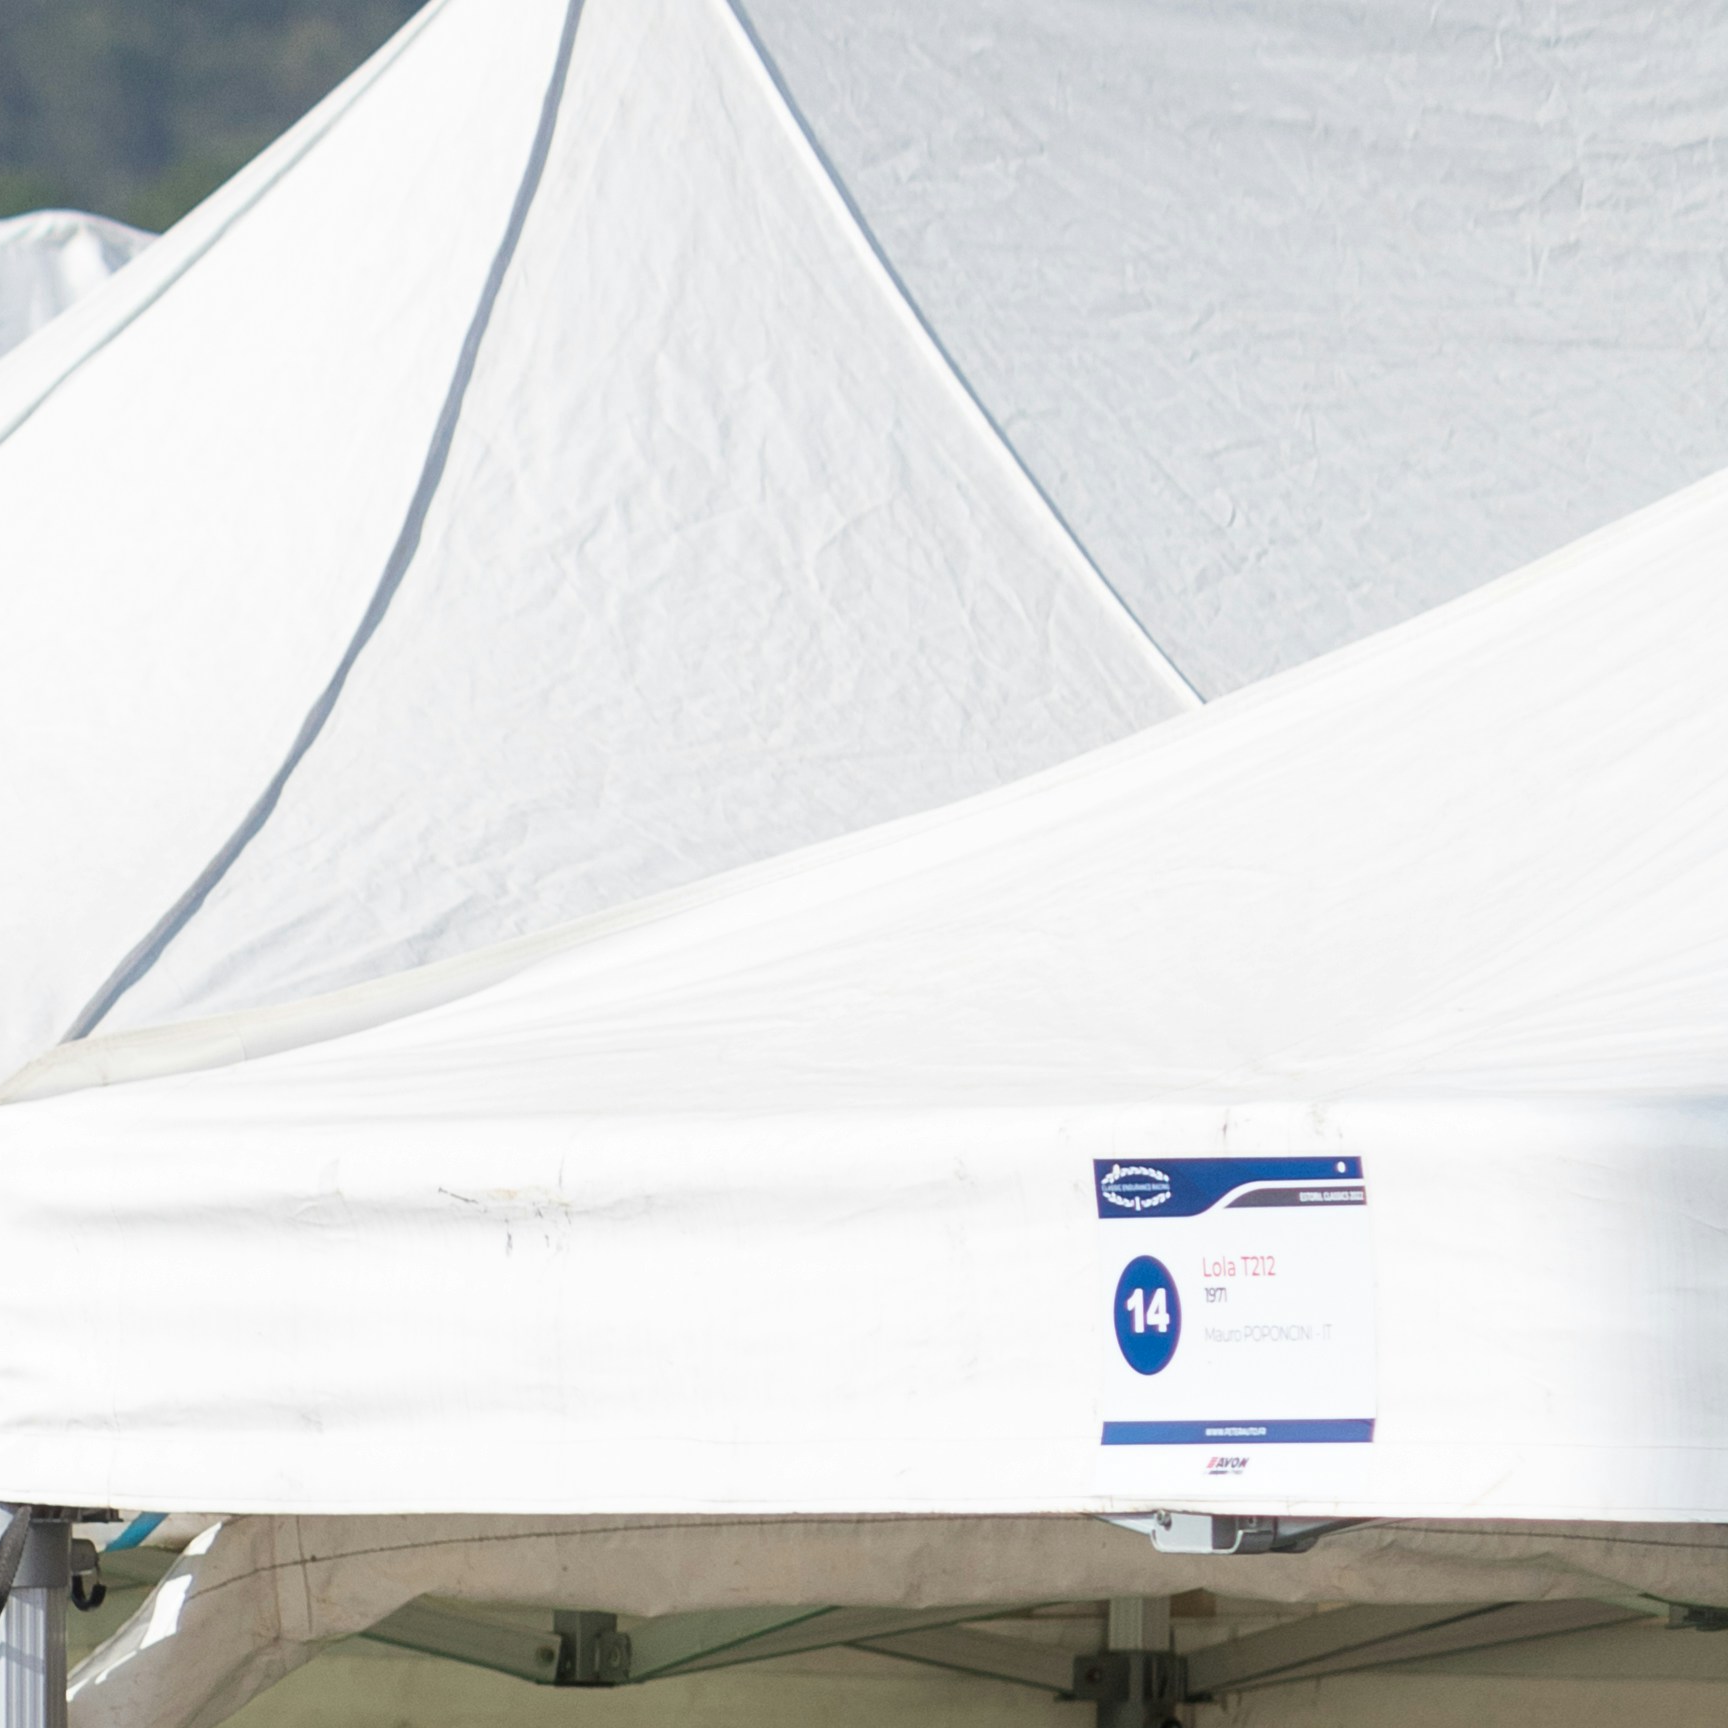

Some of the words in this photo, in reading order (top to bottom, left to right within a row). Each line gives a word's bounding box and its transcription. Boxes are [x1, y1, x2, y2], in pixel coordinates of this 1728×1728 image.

[1202, 1256, 1236, 1278] Lola
[1240, 1255, 1276, 1277] T212
[1126, 1287, 1170, 1333] 14
